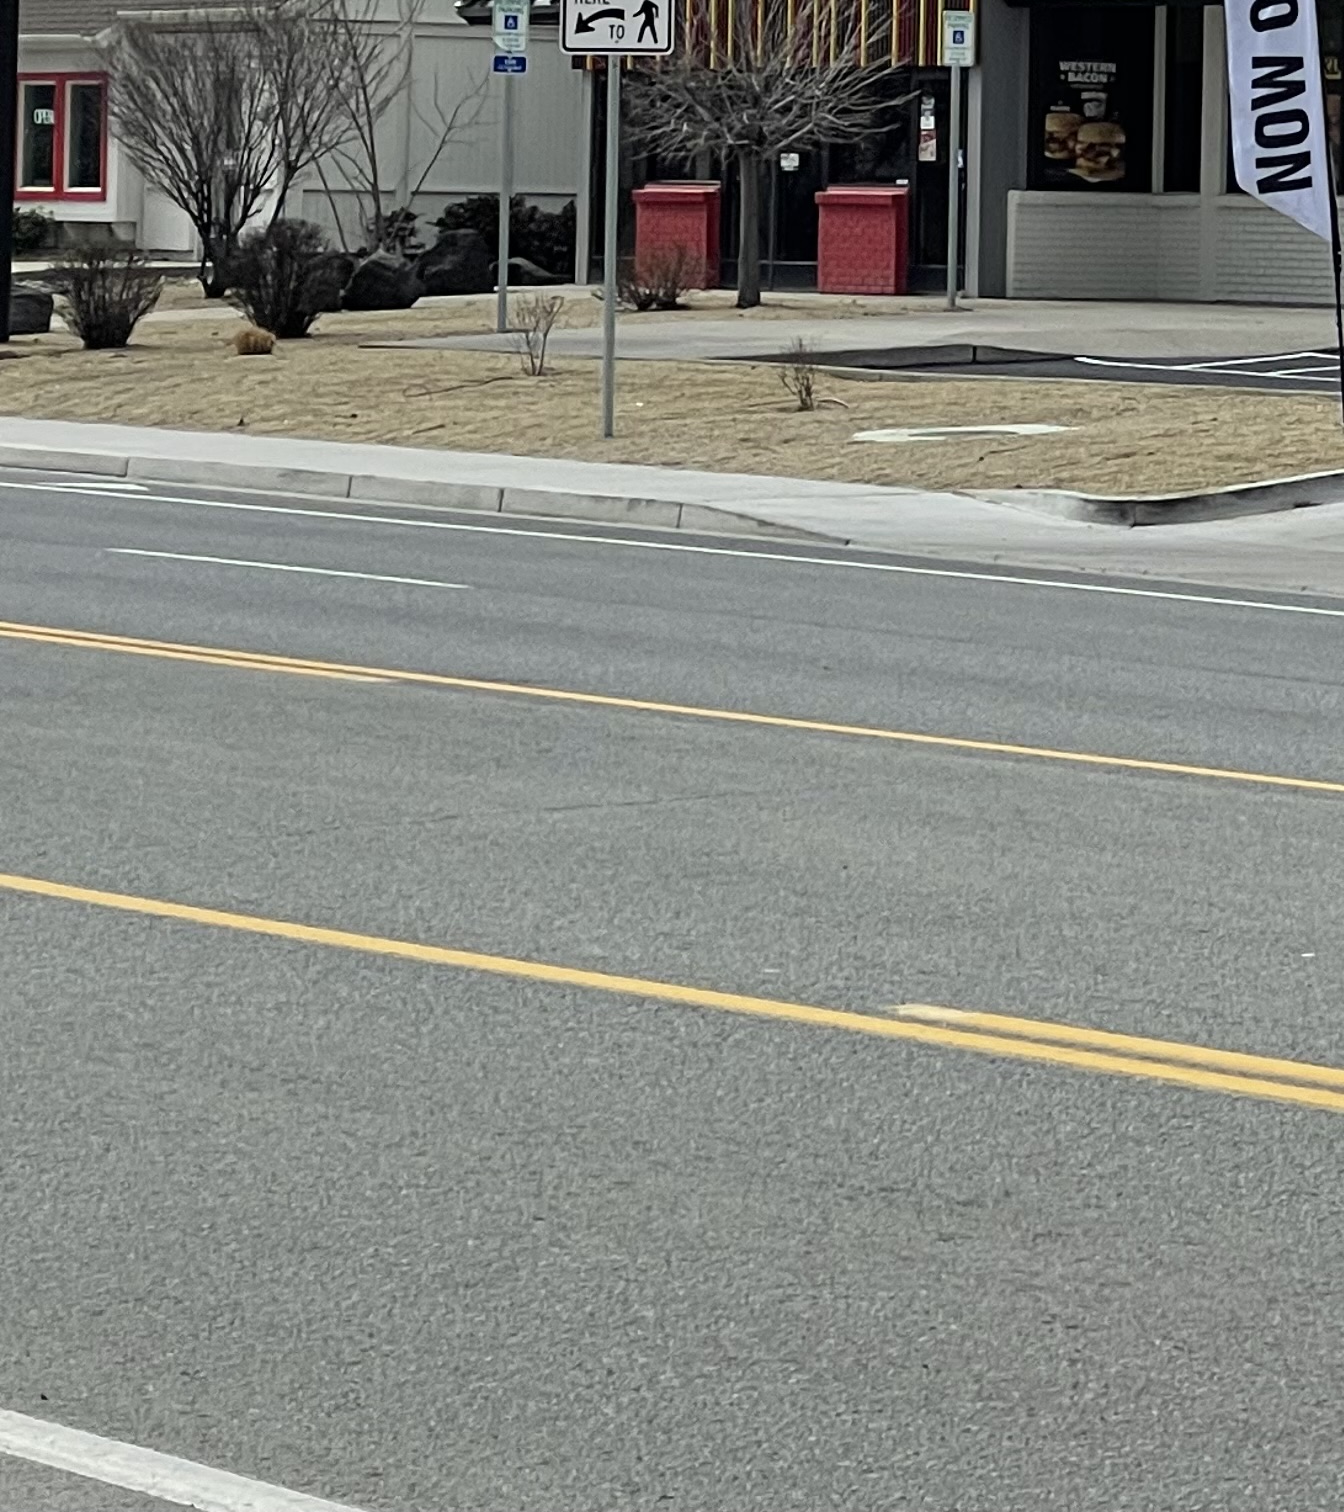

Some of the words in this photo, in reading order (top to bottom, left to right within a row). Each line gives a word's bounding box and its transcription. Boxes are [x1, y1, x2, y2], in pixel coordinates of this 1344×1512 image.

[608, 24, 626, 41] TO
[1059, 60, 1117, 73] WESTERN
[1067, 71, 1109, 83] BACON
[1251, 54, 1314, 196] NOW
